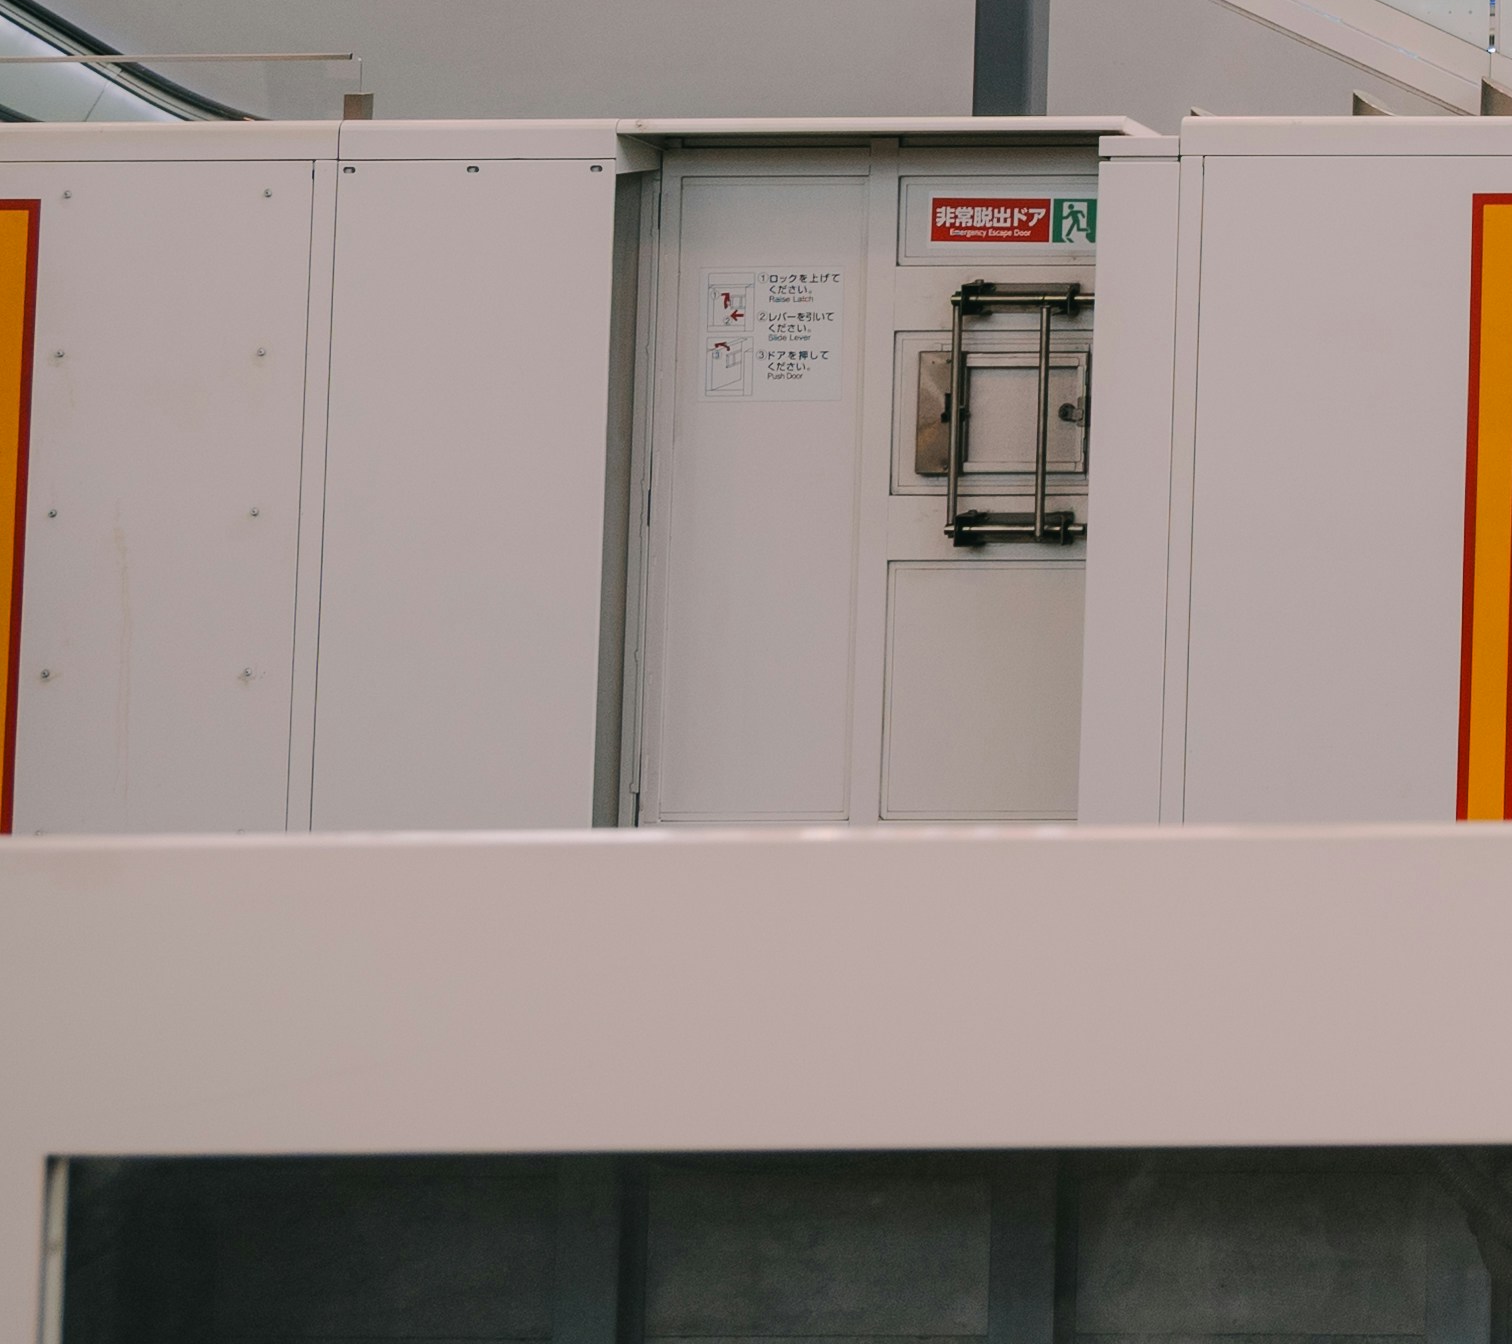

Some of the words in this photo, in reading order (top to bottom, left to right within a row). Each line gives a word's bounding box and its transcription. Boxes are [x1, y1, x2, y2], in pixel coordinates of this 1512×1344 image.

[936, 206, 1046, 227] 非常脱出ドア
[950, 228, 987, 238] Emergency
[988, 228, 1013, 238] Escape
[1013, 229, 1032, 237] Door
[769, 285, 812, 295] ください。
[769, 324, 812, 333] ください。
[768, 362, 811, 372] ください。
[767, 372, 785, 380] Push
[786, 372, 803, 380] Door
